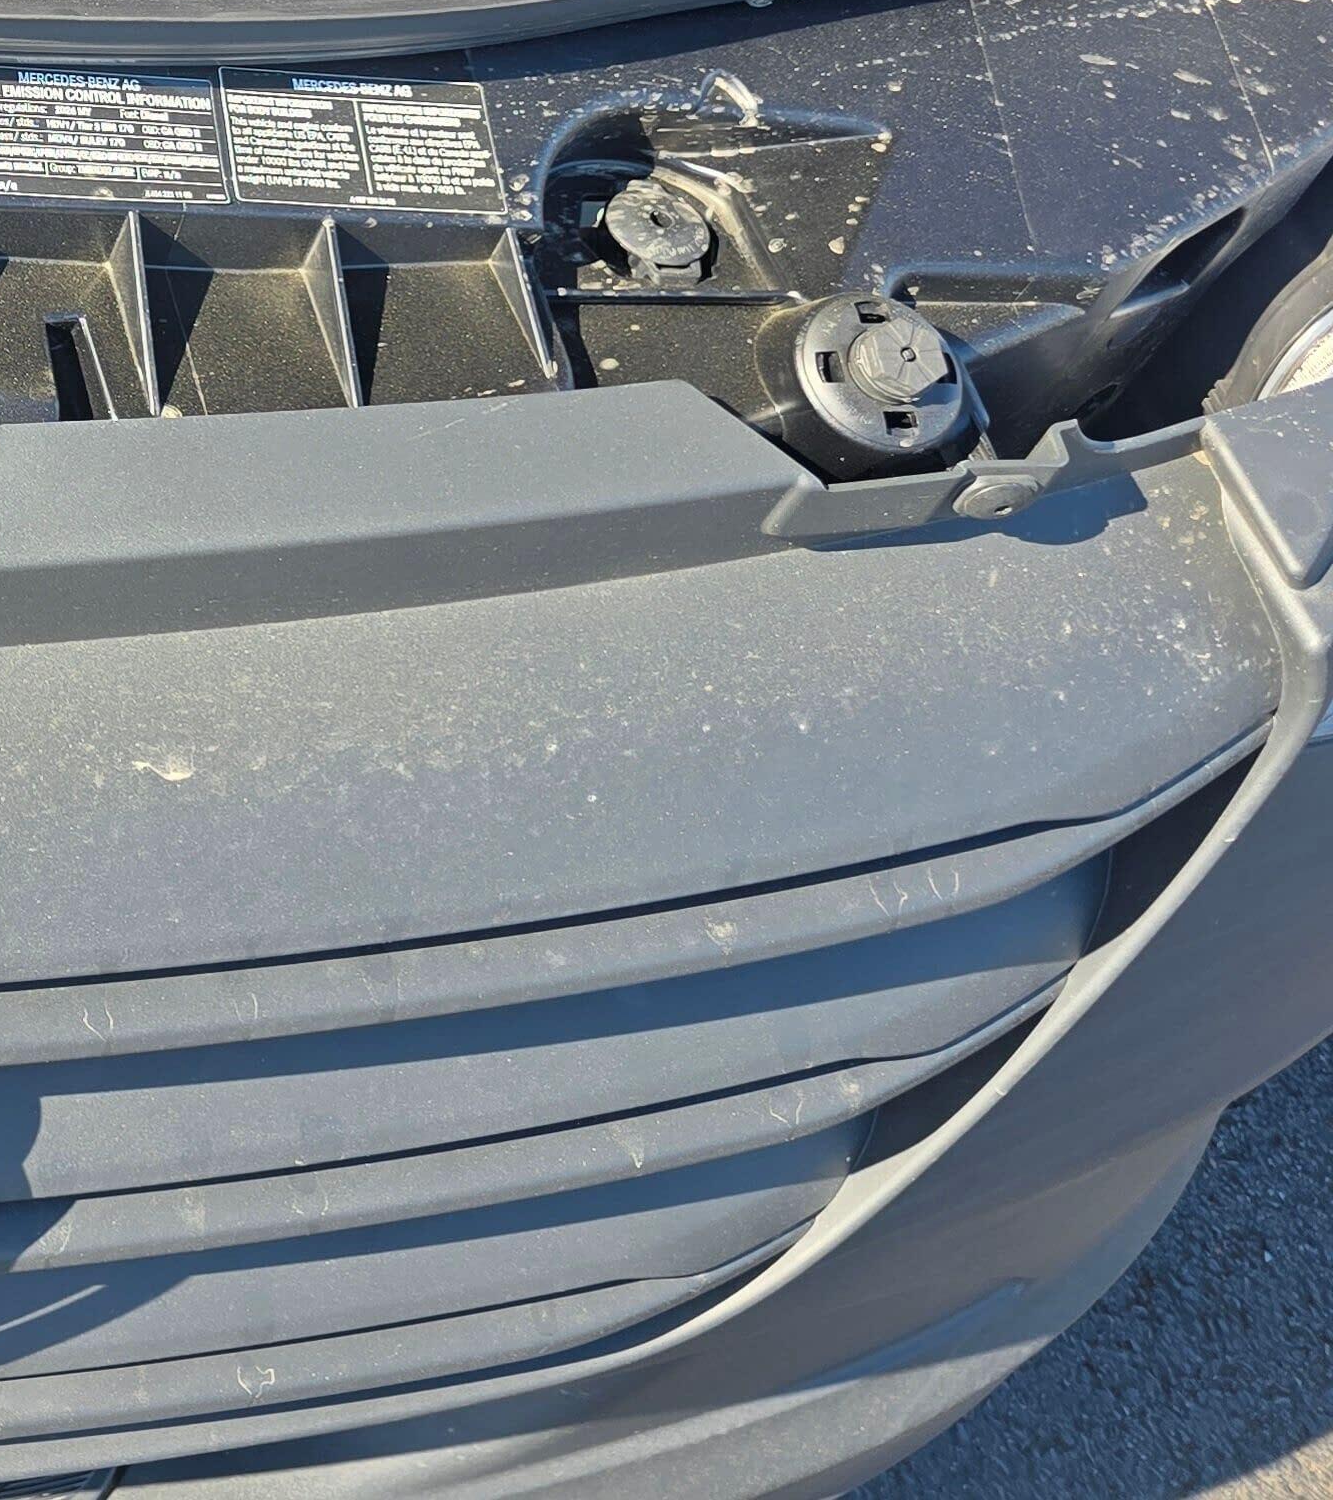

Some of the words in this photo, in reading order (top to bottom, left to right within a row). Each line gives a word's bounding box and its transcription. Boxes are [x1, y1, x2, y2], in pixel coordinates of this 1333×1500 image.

[18, 71, 120, 90] MERCEDES-BENZ
[122, 79, 141, 92] AG
[2, 84, 63, 100] EMISSION
[64, 87, 125, 104] CONTROL
[126, 92, 212, 110] INFORMATION
